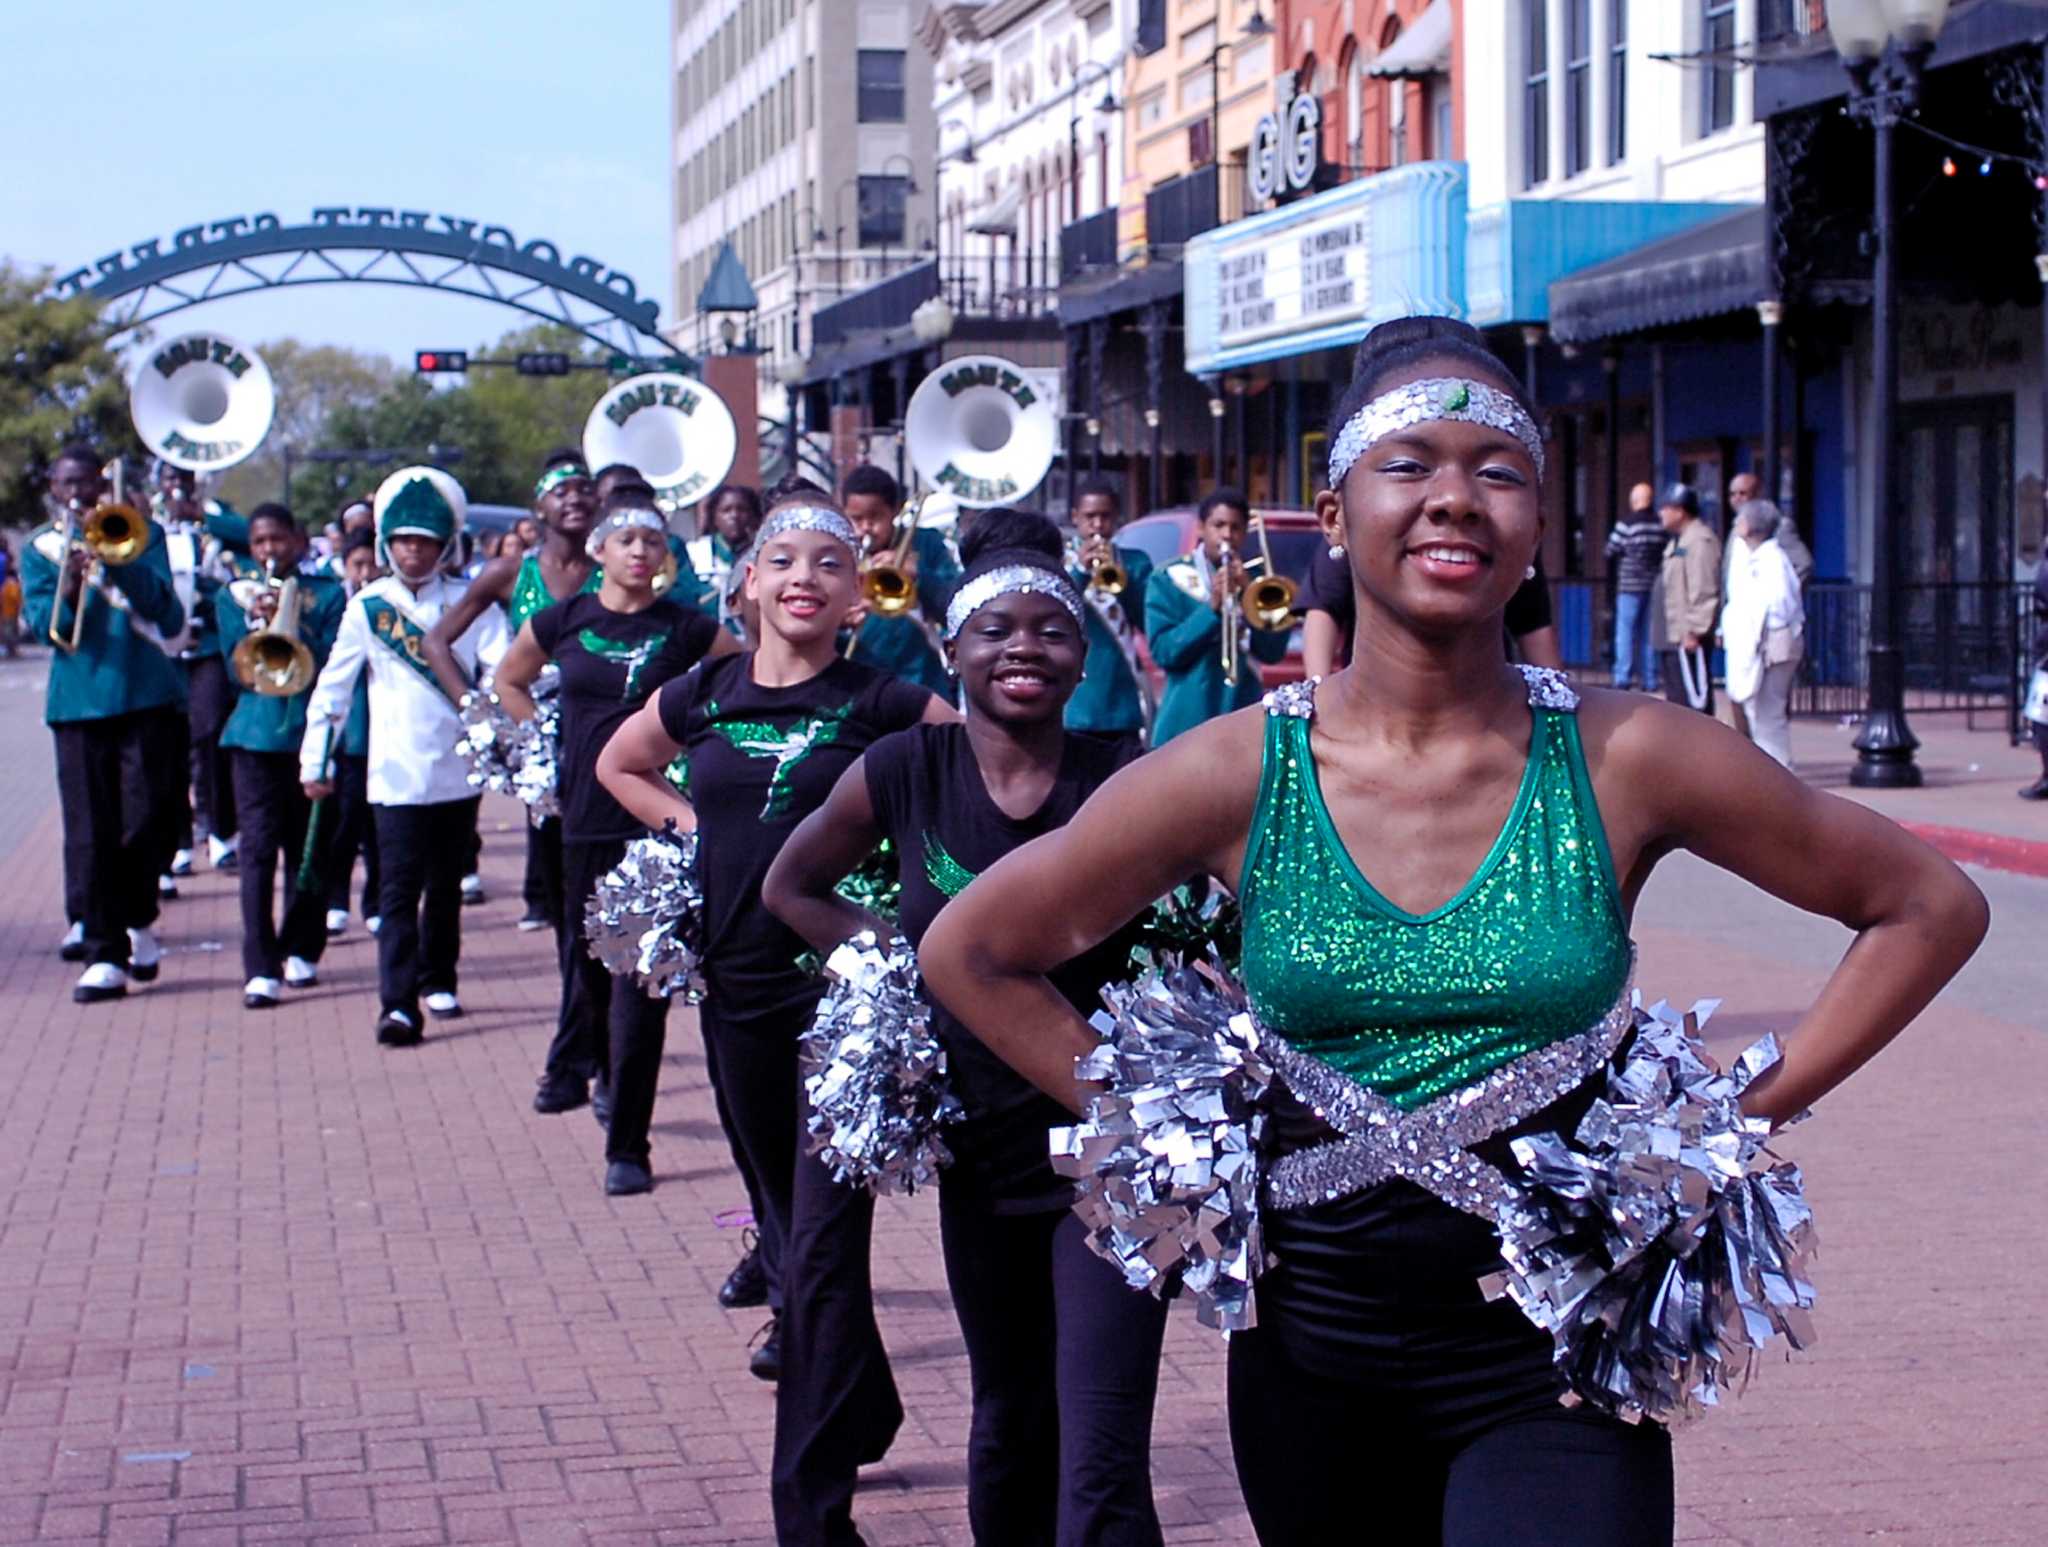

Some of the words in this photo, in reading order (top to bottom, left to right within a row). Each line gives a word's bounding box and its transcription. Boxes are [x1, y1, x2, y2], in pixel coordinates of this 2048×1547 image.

[1248, 93, 1318, 200] GIG
[153, 338, 251, 379] SOUTH
[605, 384, 701, 427] SOUTH
[939, 364, 1036, 410] SOUTH
